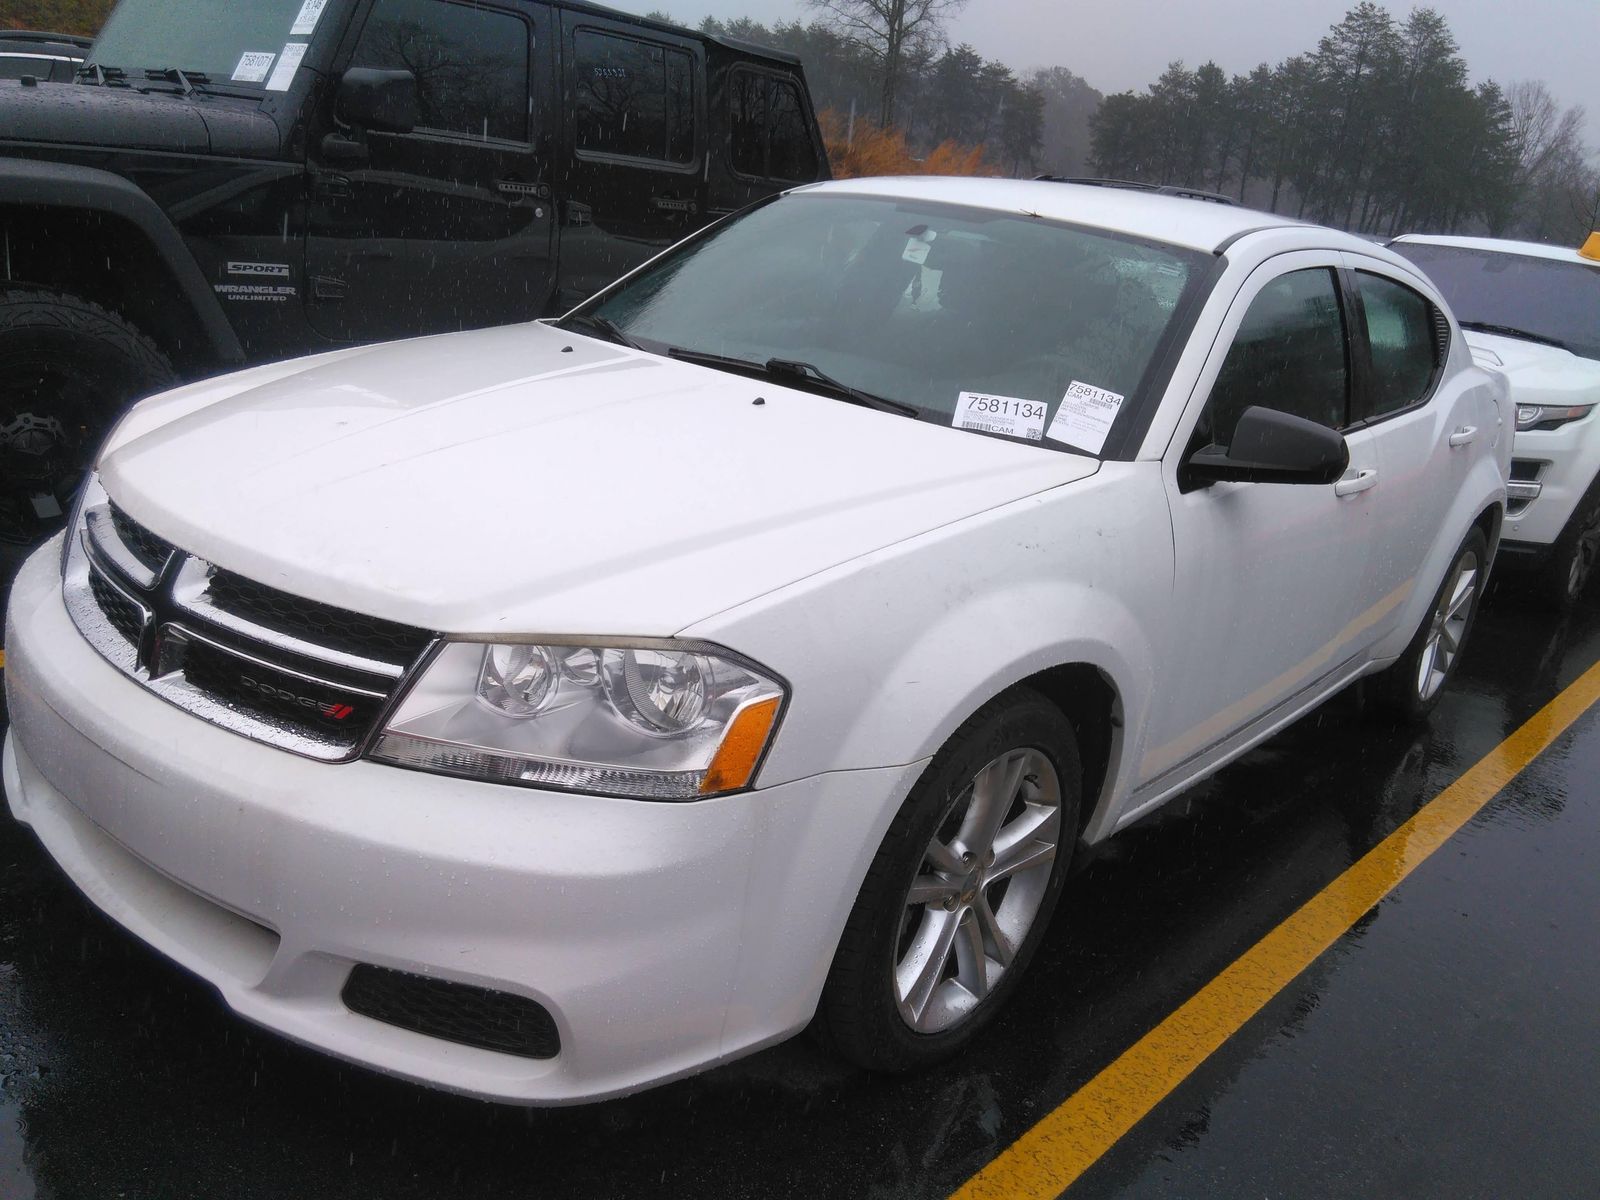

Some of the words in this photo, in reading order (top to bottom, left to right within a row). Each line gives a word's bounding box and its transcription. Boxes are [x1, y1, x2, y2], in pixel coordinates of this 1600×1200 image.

[241, 54, 272, 67] 7581071
[229, 264, 289, 274] SPORT
[213, 284, 297, 295] WRANGLER
[227, 294, 287, 302] UNLIMITED
[1067, 391, 1083, 400] CAM
[1069, 383, 1122, 406] 7581134
[967, 396, 1044, 420] 7581134
[991, 425, 1015, 435] CAM
[240, 675, 336, 715] DODGE
